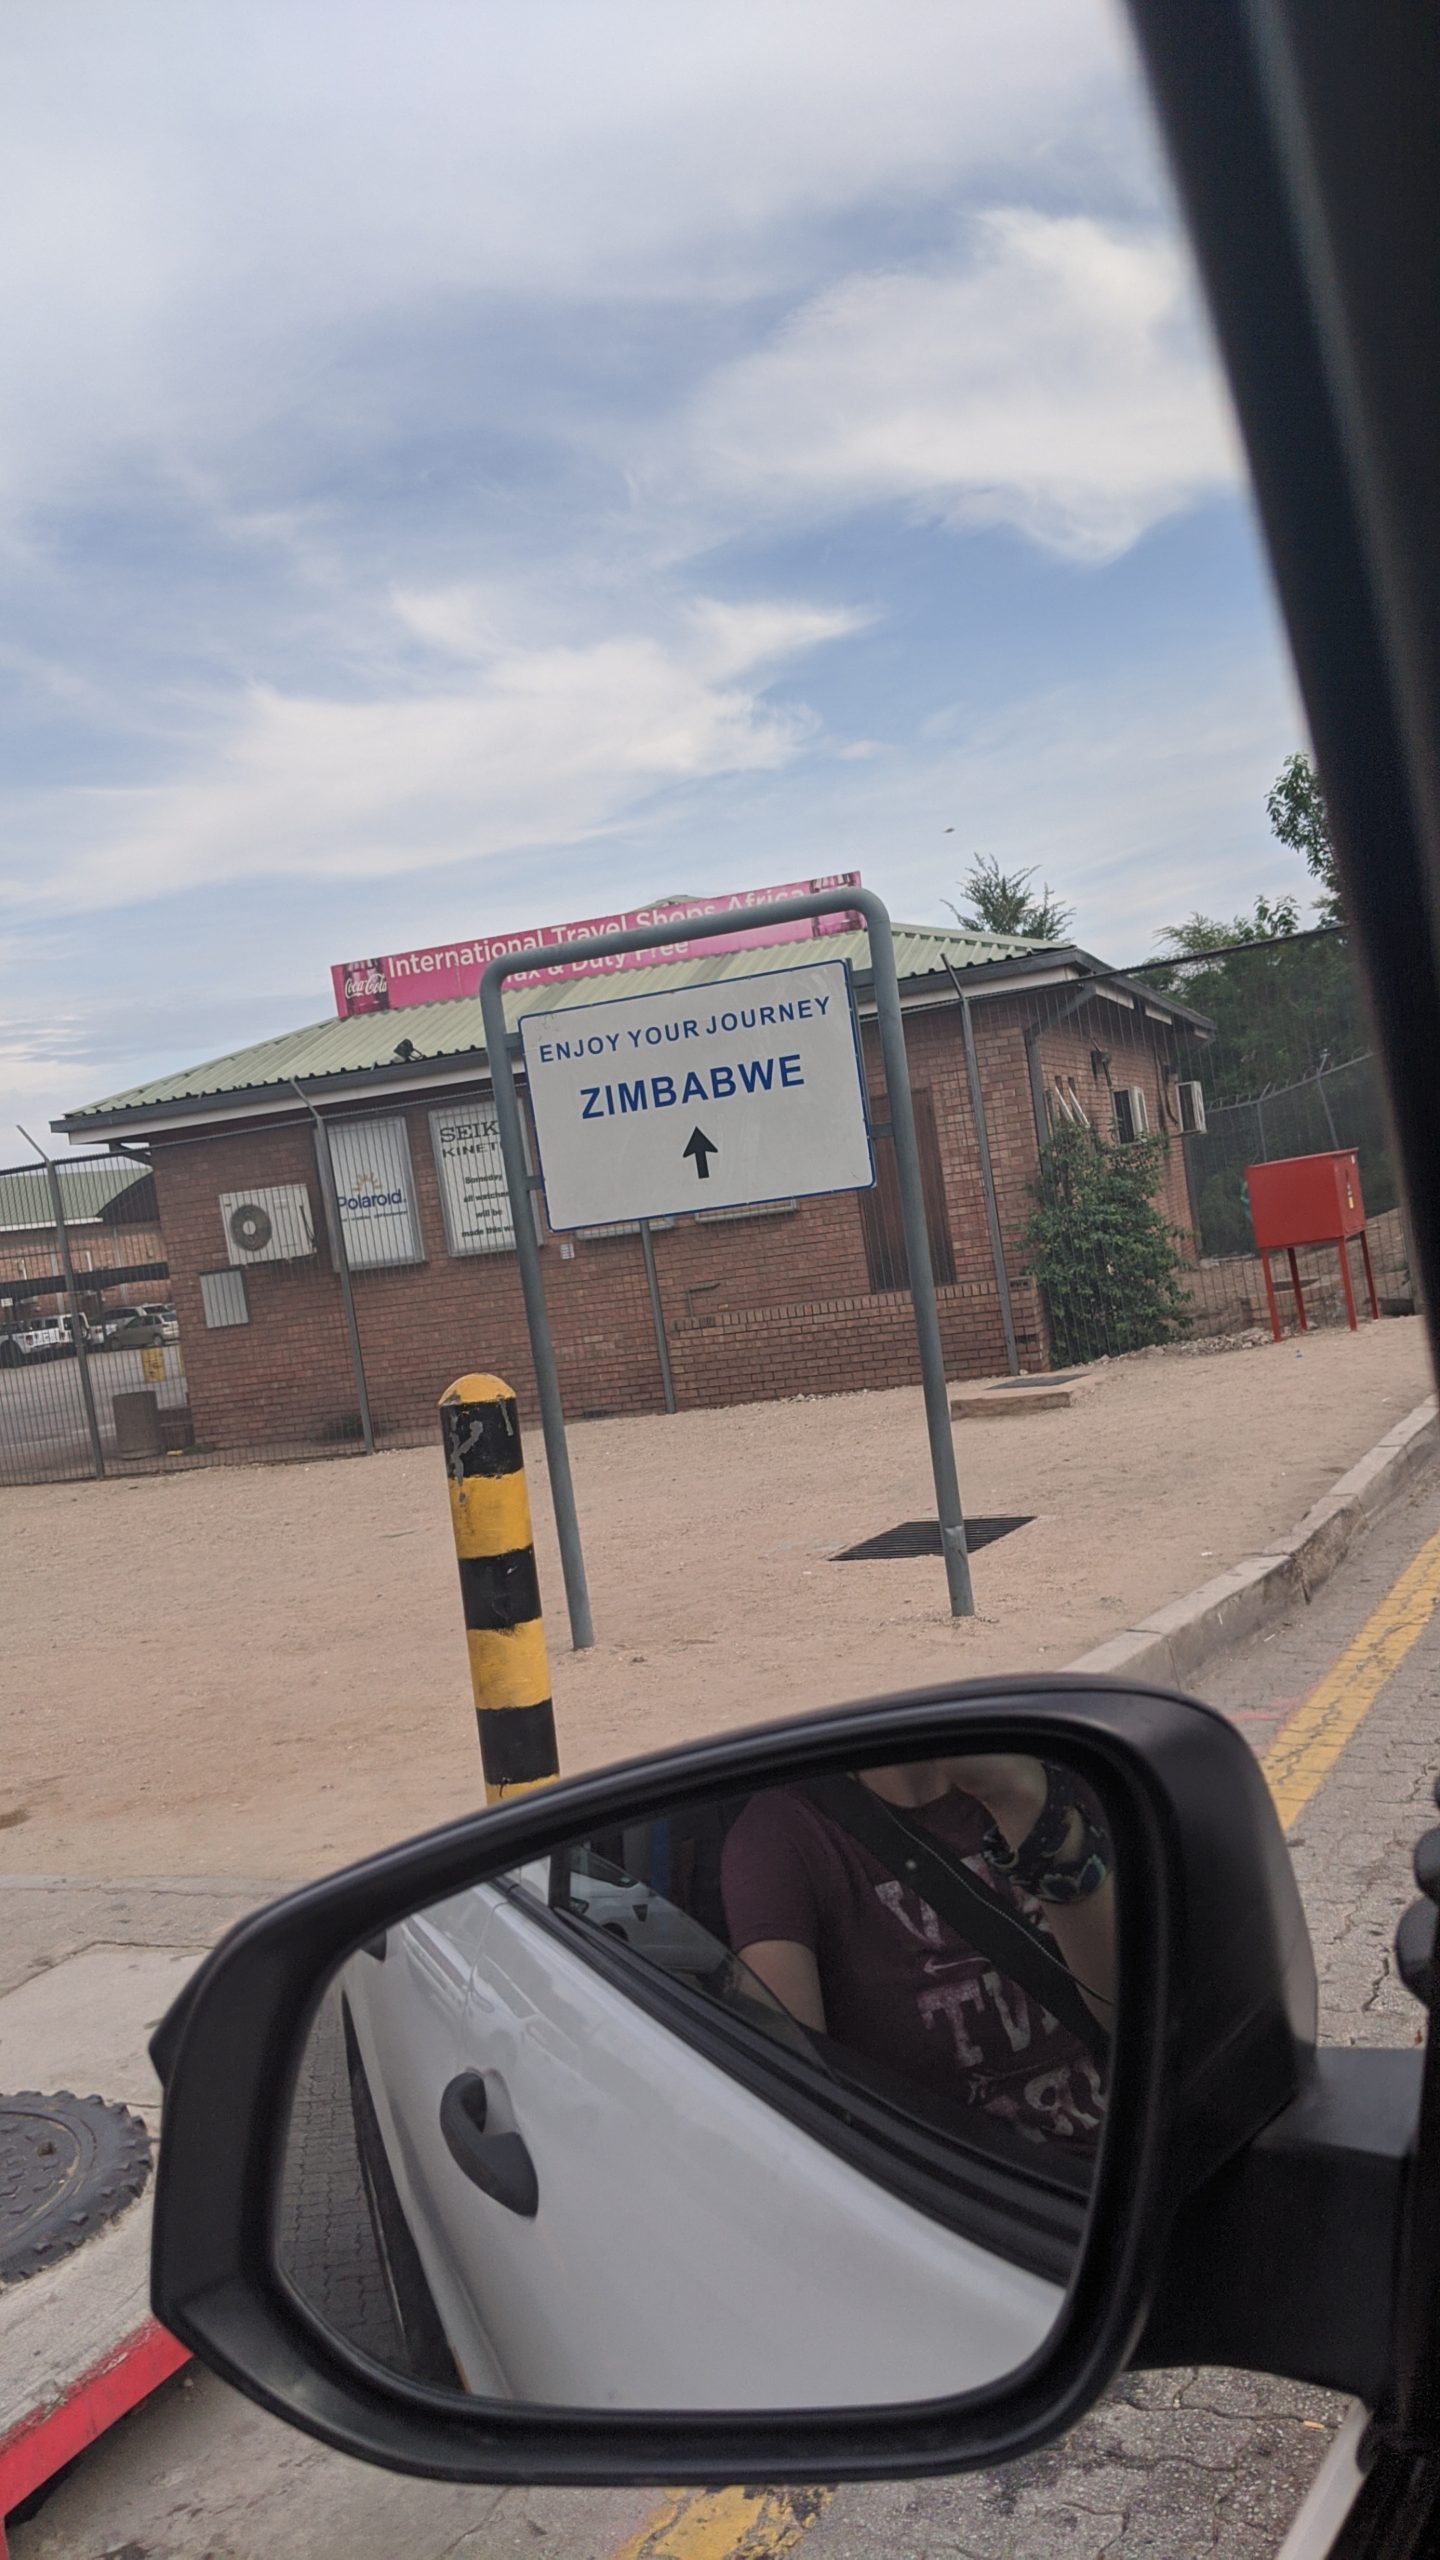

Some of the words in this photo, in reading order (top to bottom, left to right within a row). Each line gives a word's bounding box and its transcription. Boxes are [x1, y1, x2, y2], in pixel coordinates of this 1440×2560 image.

[388, 929, 545, 978] International
[550, 914, 628, 944] Travel
[636, 905, 716, 927] Shops
[539, 1033, 621, 1063] ENJOY
[628, 1019, 700, 1049] YOUR
[706, 996, 831, 1035] JOURNEY
[579, 1053, 805, 1120] ZIMBABWE
[440, 1120, 500, 1143] SEIK
[443, 1142, 498, 1158] KINET
[475, 1191, 509, 1202] watche
